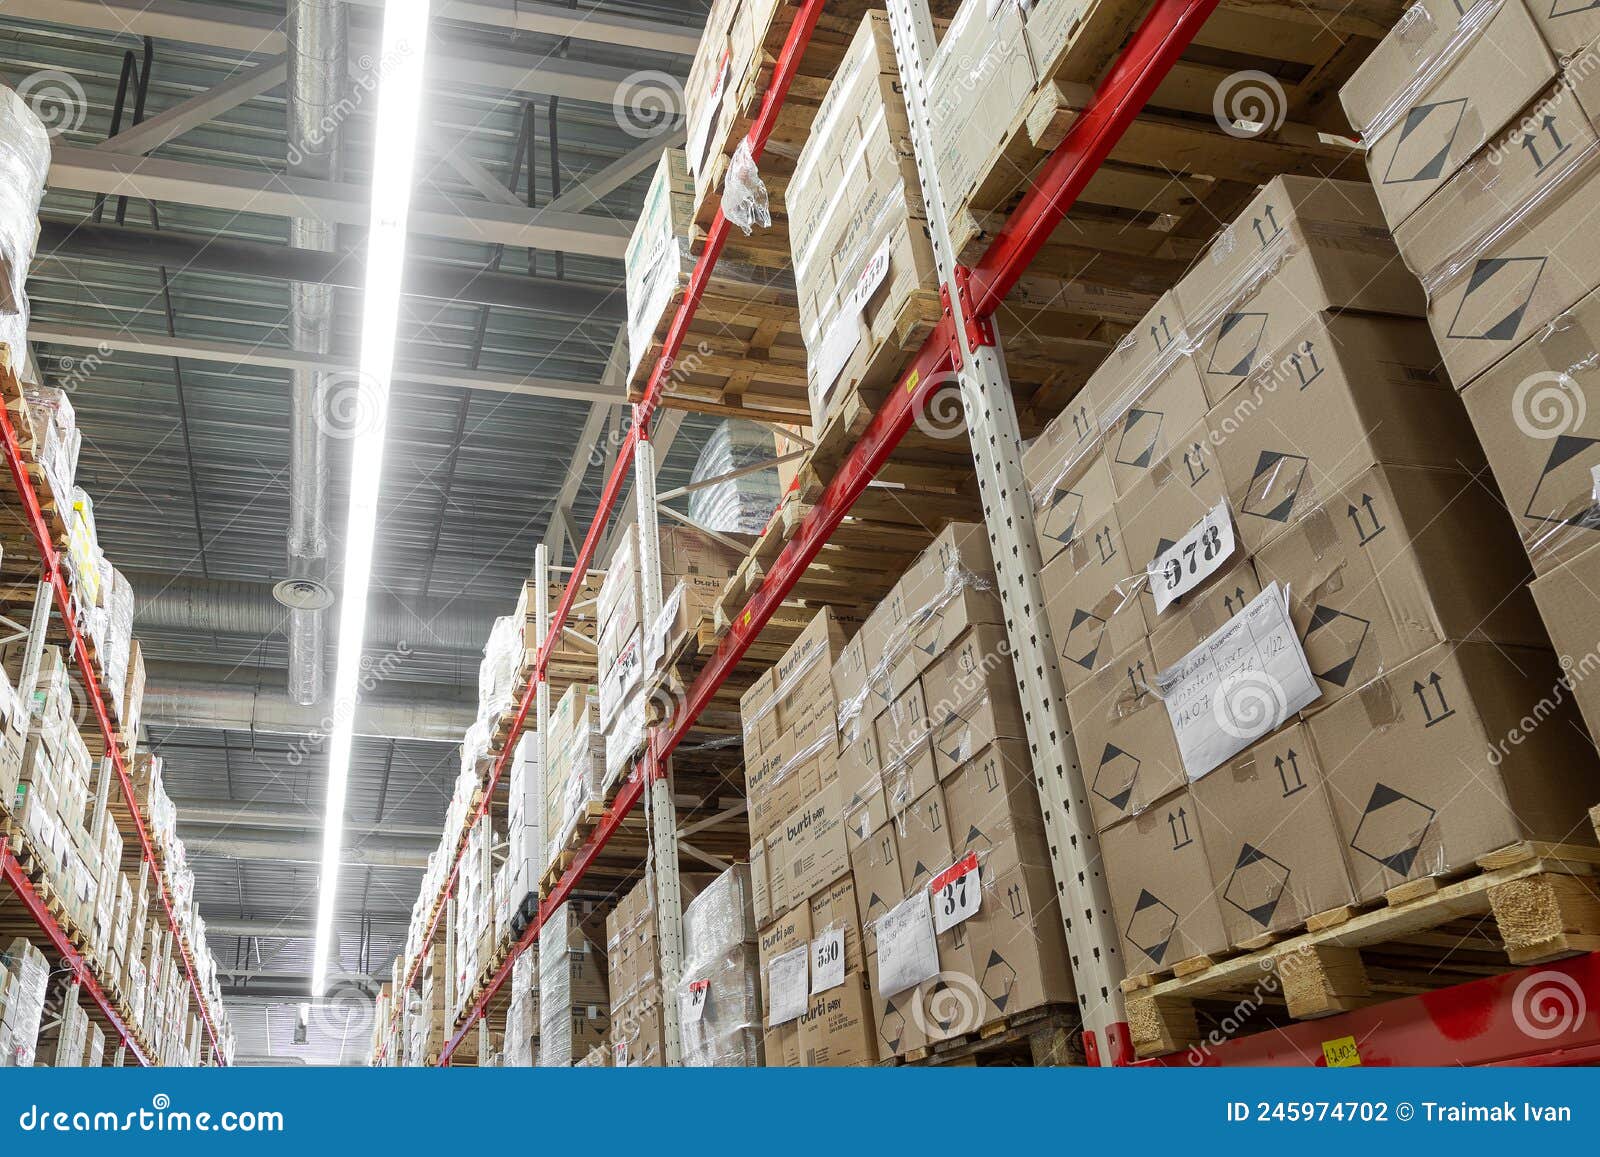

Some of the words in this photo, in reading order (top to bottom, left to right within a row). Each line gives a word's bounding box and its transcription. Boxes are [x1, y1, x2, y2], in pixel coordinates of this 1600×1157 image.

[1164, 525, 1221, 590] 978
[748, 758, 770, 789] burti
[786, 810, 812, 841] burti
[943, 875, 968, 915] 37
[762, 925, 783, 951] burti
[817, 940, 839, 968] 530
